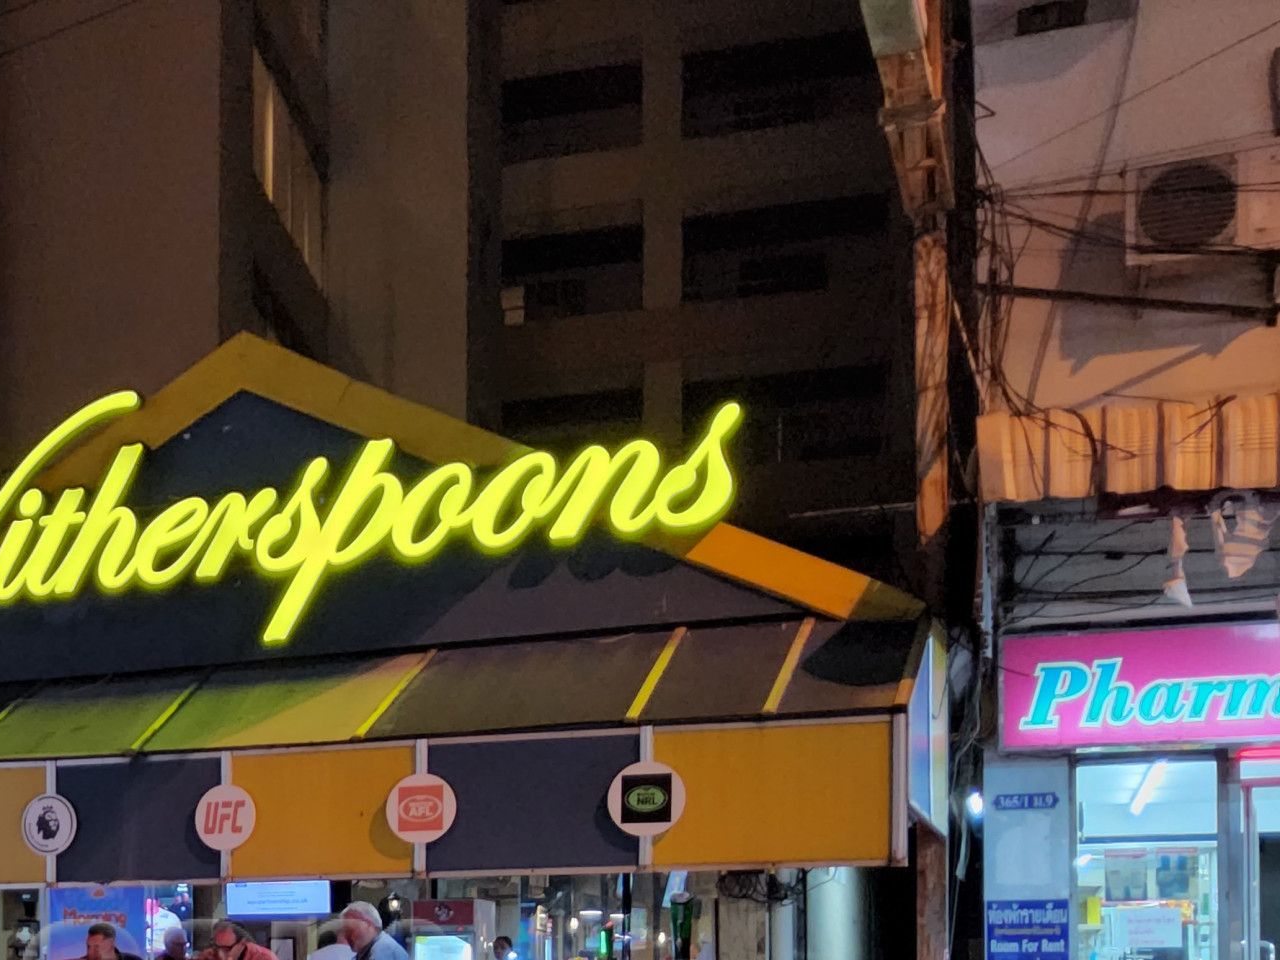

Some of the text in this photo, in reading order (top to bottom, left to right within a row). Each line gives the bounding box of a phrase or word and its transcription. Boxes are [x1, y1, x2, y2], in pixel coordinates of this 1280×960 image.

[203, 800, 246, 835] UFC
[408, 804, 434, 817] AFL
[990, 939, 1066, 953] Room For Rent
